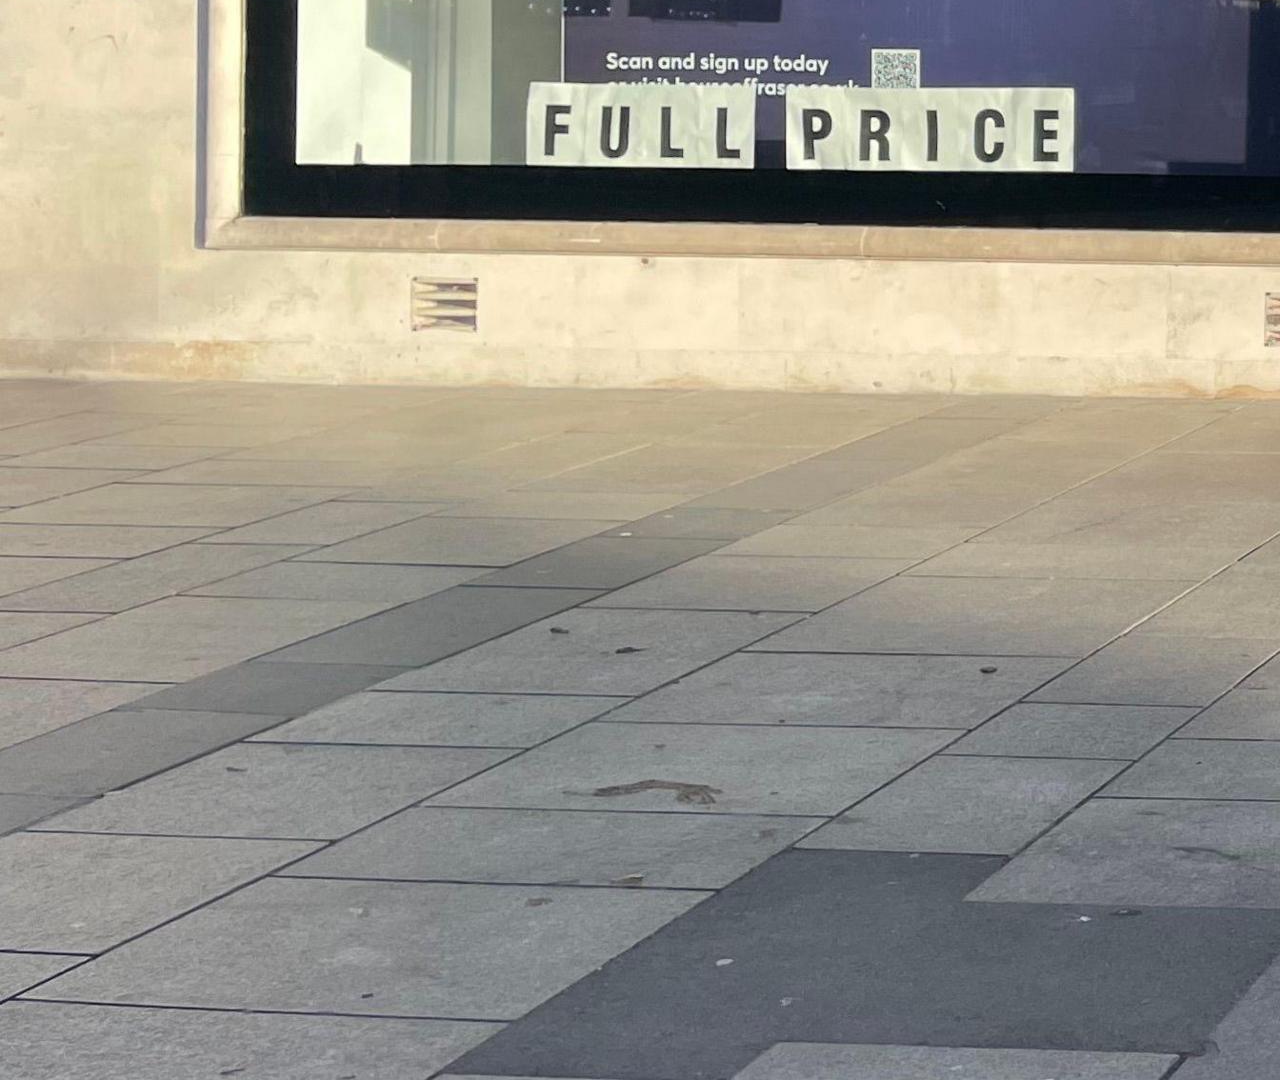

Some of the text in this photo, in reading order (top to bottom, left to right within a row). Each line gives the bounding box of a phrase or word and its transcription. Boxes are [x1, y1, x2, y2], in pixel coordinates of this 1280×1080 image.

[606, 52, 829, 75] Scan and sign up today
[544, 104, 1059, 163] FULL PRICE
